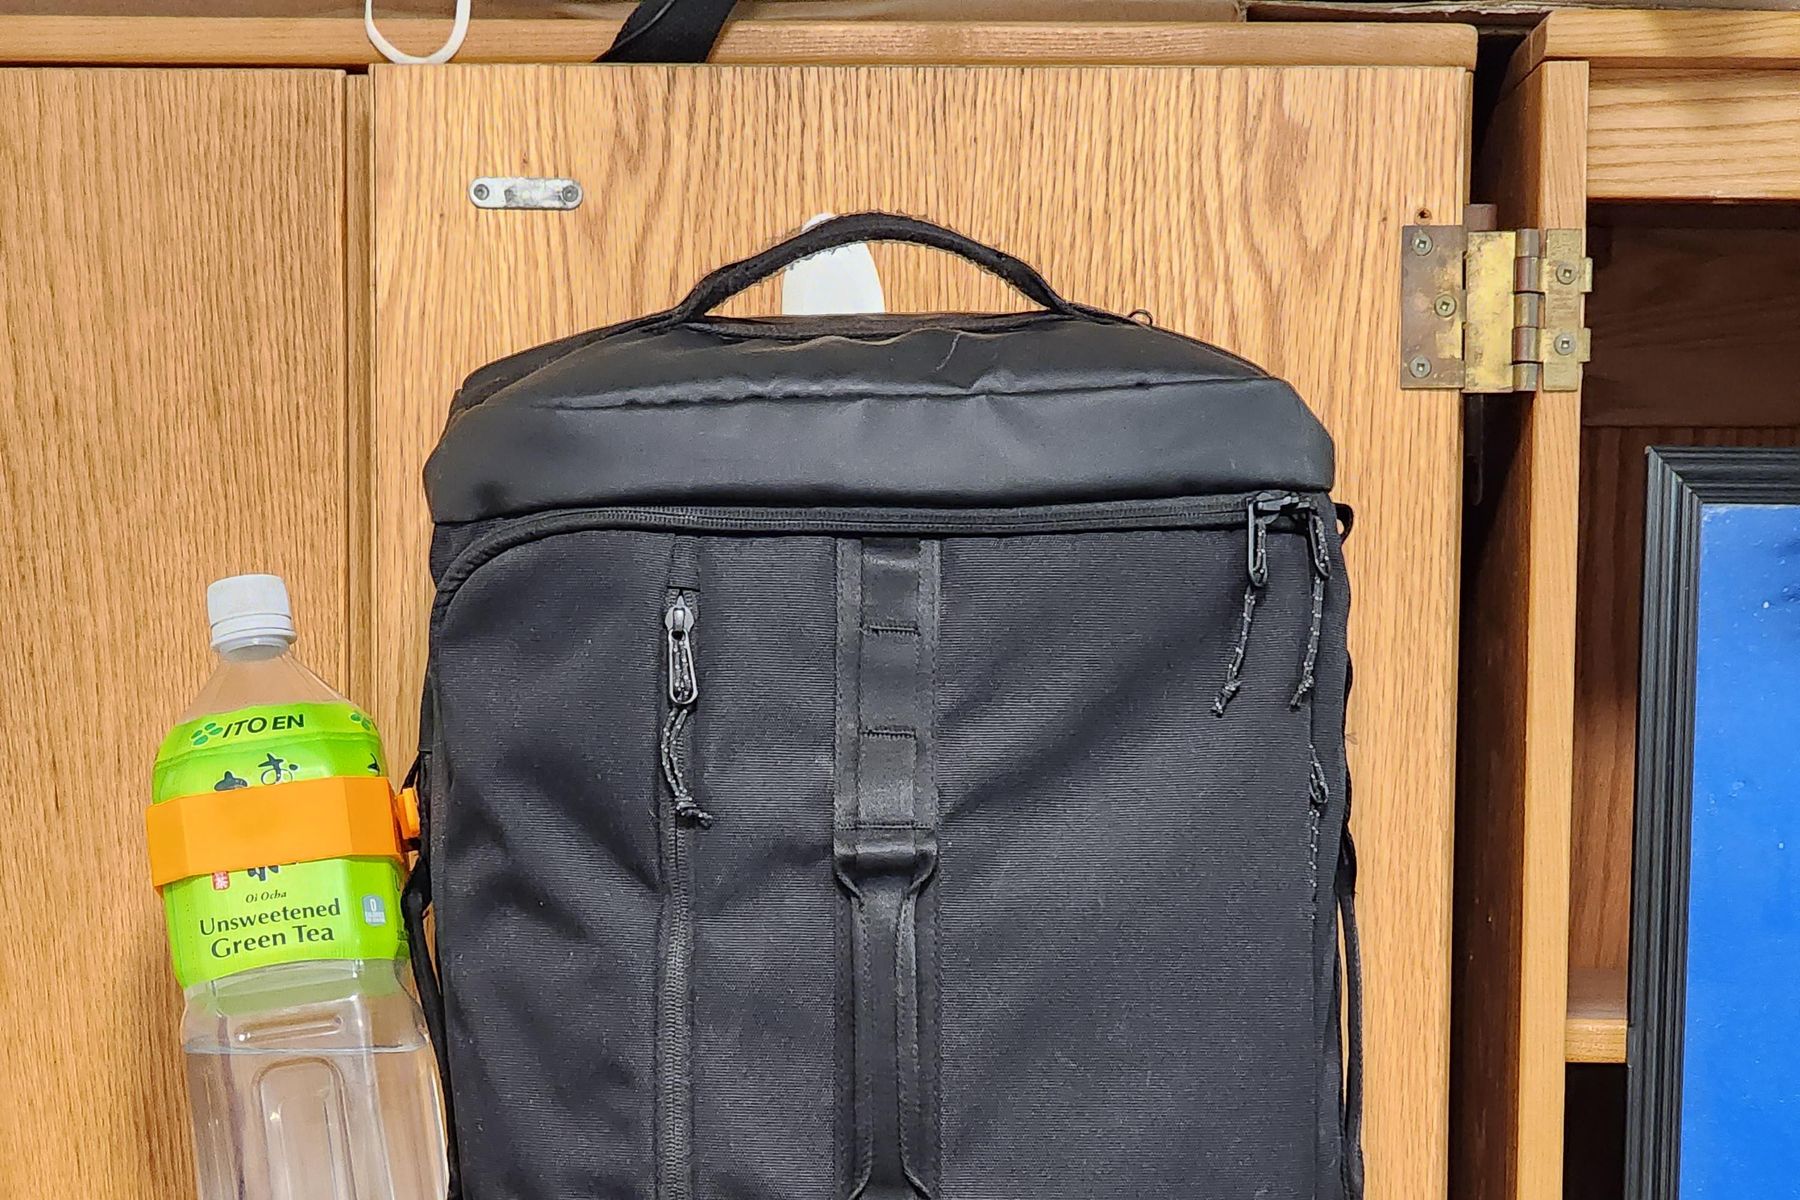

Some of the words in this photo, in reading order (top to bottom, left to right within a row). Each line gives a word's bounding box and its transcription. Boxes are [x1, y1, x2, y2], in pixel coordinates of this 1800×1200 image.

[222, 717, 267, 738] ITO
[271, 713, 305, 730] EN
[245, 893, 258, 904] Oi
[260, 889, 287, 902] Ocha
[199, 898, 341, 936] Unsweetened
[210, 930, 287, 959] Green
[292, 924, 335, 944] Tea
